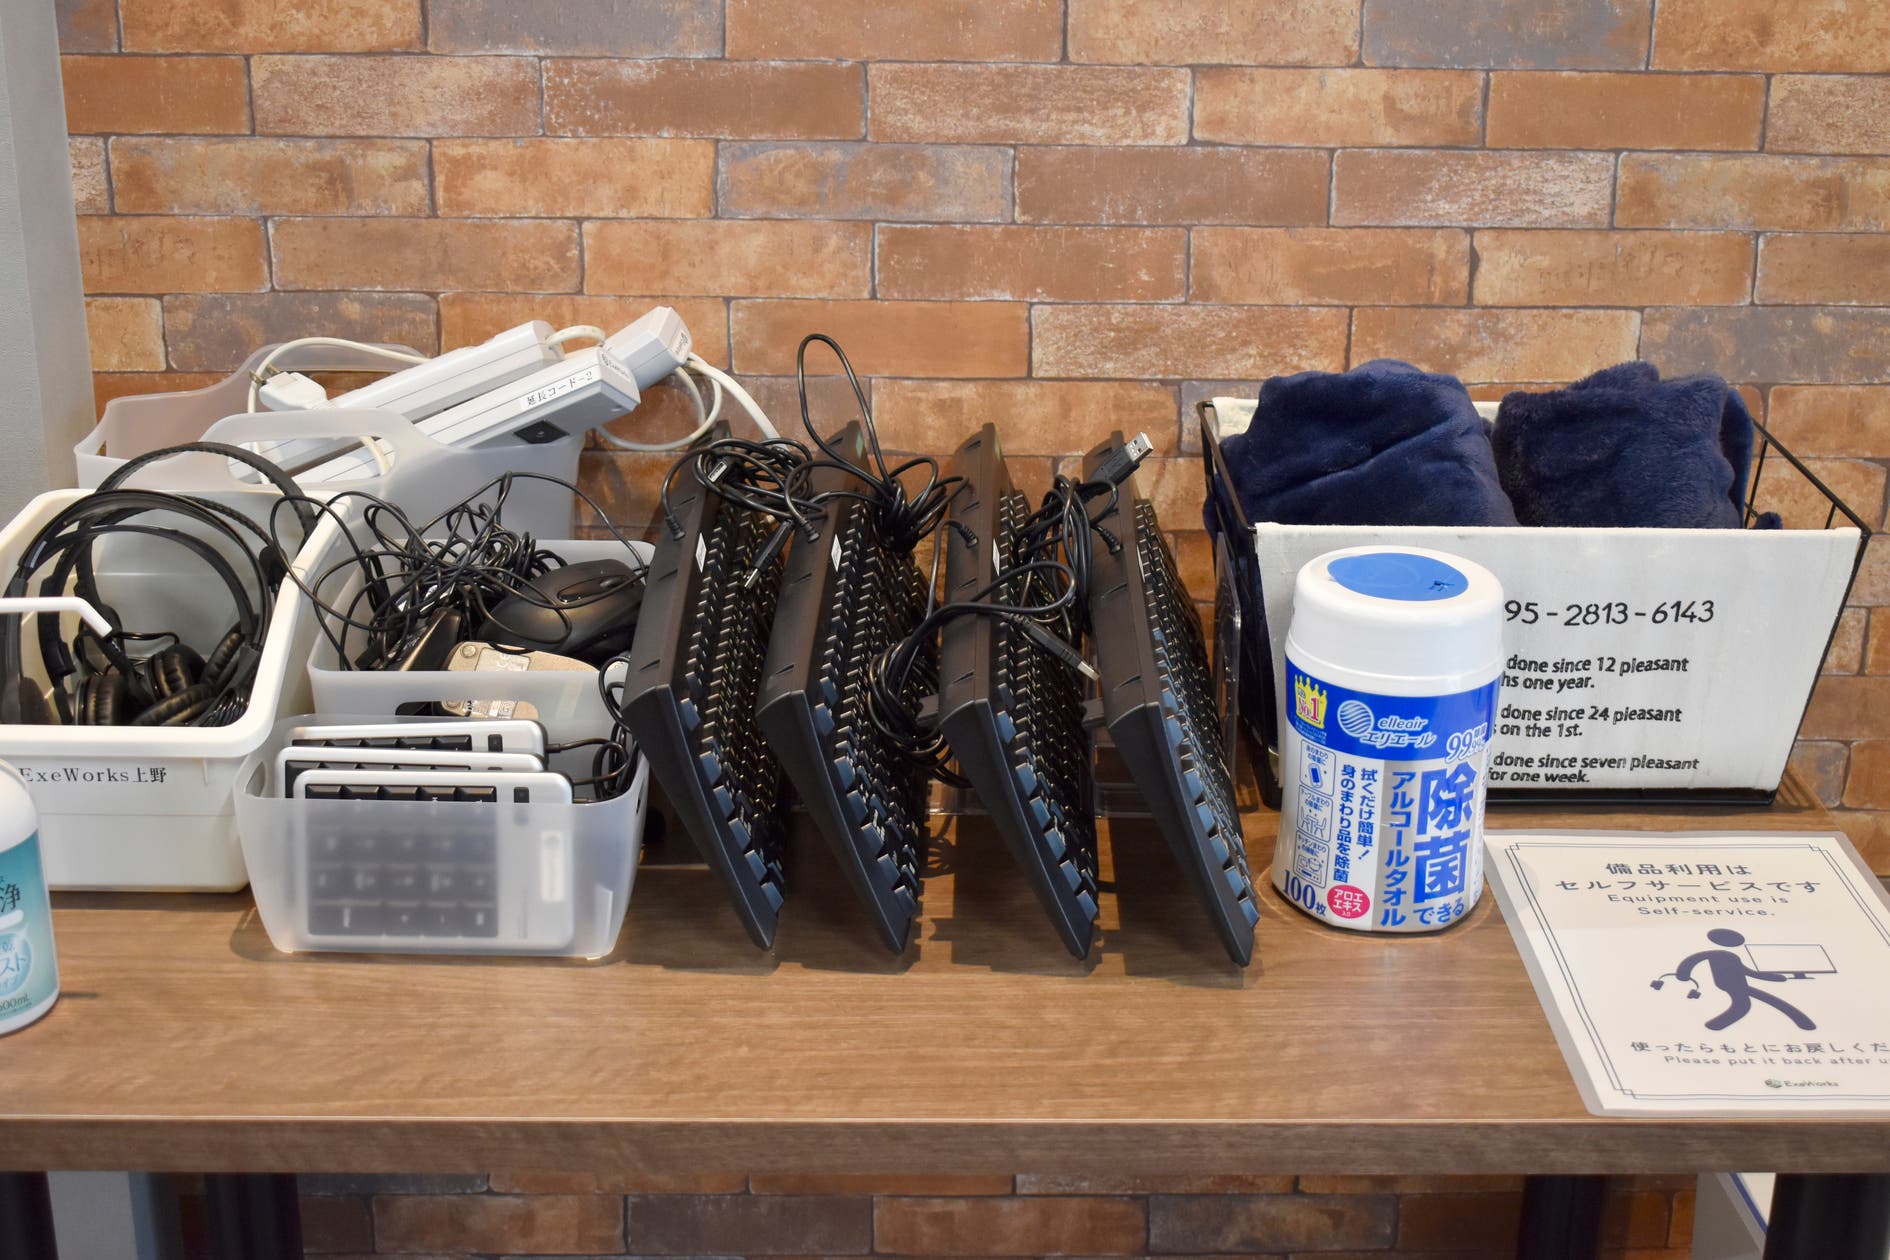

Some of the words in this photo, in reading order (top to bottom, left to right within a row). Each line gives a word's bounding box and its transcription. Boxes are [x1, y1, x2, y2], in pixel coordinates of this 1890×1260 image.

[1507, 654, 1548, 673] done
[1552, 657, 1591, 673] since
[1597, 657, 1616, 672] 12
[1619, 657, 1689, 676] pleasant
[1523, 676, 1554, 690] one
[1557, 675, 1595, 693] year.
[1501, 704, 1542, 721] done
[1545, 706, 1585, 721] since
[1588, 706, 1610, 721] 24
[1613, 707, 1682, 725] pleasant
[1378, 715, 1428, 731] elleair
[1500, 723, 1520, 736] on
[1525, 723, 1552, 738] the
[1557, 723, 1583, 737] 1st.
[1361, 731, 1436, 748] エリエール
[1493, 752, 1534, 768] done
[1537, 754, 1578, 768] since
[1581, 757, 1626, 769] seven
[1630, 754, 1700, 771] pleasant
[1510, 770, 1540, 782] one
[1544, 770, 1590, 783] week.
[1381, 771, 1416, 927] アルコールタオル
[1605, 863, 1753, 876] 備品利用は
[1555, 879, 1821, 893] セルフサービスです
[1334, 888, 1363, 903] アロエ
[1607, 894, 1720, 905] Equipment
[1728, 895, 1763, 904] use
[1770, 895, 1789, 904] is
[1333, 899, 1362, 912] エキス
[1637, 906, 1776, 917] Self-service.
[1664, 1055, 1721, 1065] Please
[1728, 1057, 1756, 1067] put
[1763, 1056, 1776, 1065] it
[1782, 1056, 1822, 1065] back
[1830, 1056, 1871, 1065] after
